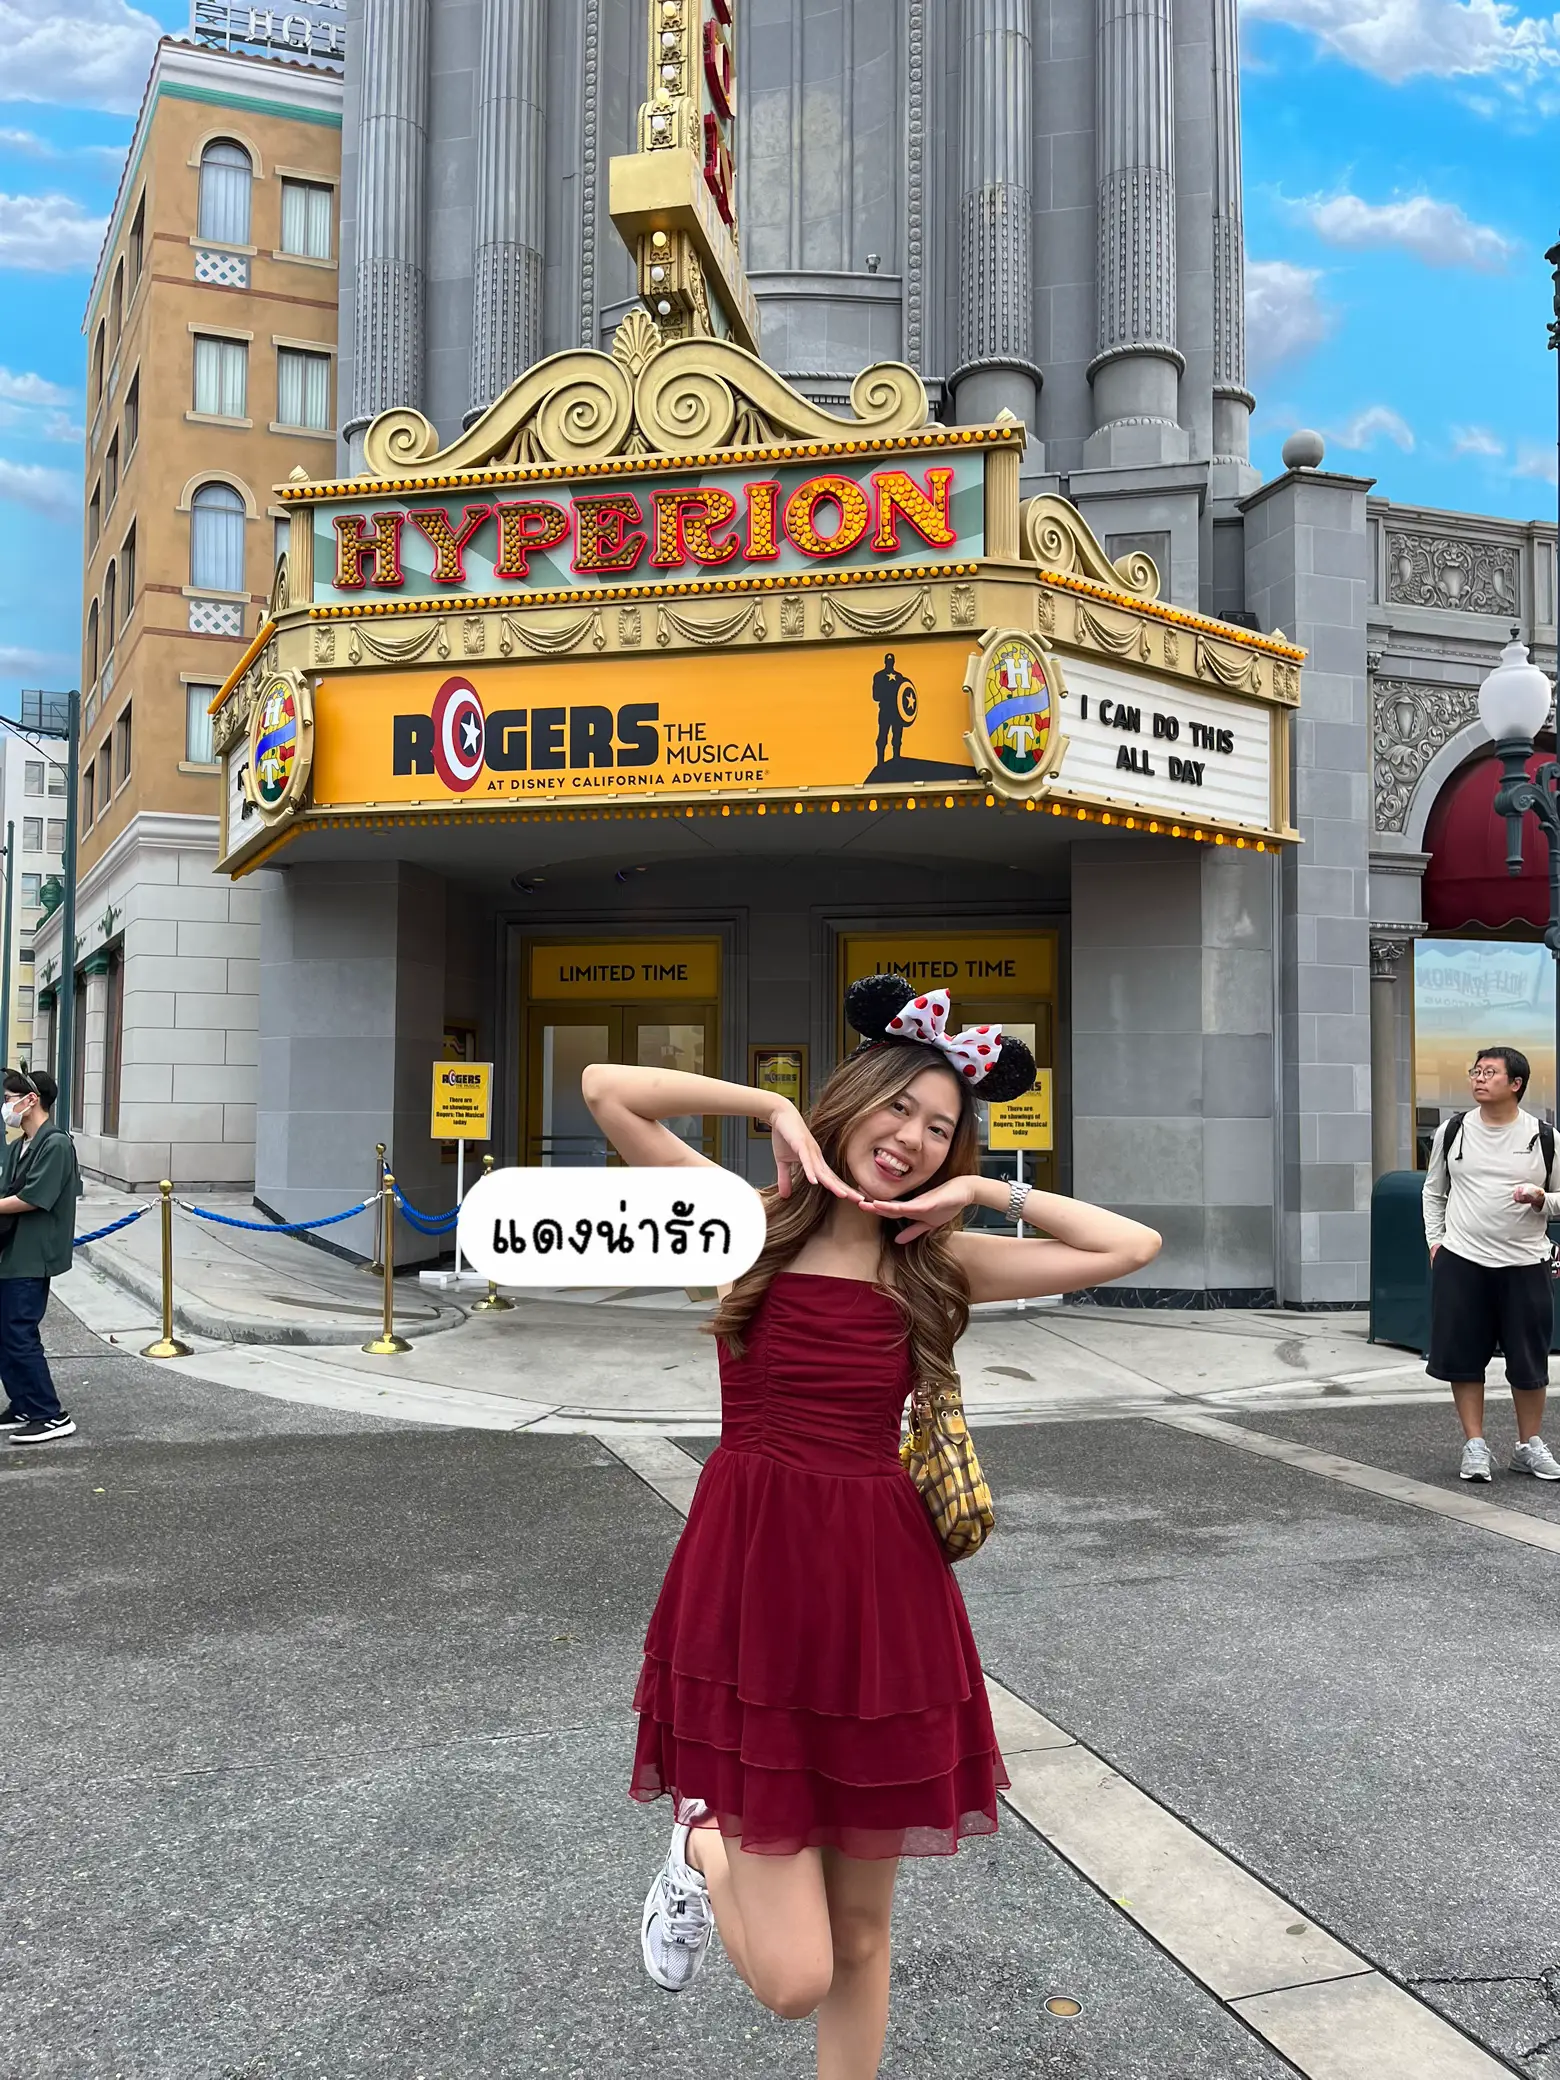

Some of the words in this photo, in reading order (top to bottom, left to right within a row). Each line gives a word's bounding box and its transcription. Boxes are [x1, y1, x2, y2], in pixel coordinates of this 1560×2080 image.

[332, 467, 955, 589] HYPERION
[393, 676, 659, 791] ROGERS
[663, 723, 706, 742] THE
[1081, 695, 1088, 719] I
[1099, 698, 1141, 734] CAN
[1153, 712, 1179, 741] DO
[1188, 721, 1235, 754] THIS
[666, 743, 769, 765] MUSICAL
[1116, 744, 1155, 776] ALL
[1168, 755, 1206, 786] DAY
[487, 780, 505, 790] AT
[511, 777, 566, 790] DISNEY
[572, 774, 665, 788] CALIFORNIA
[559, 965, 635, 982] LIMITED
[641, 964, 688, 981] TIME
[965, 960, 1016, 977] TIME
[442, 1069, 480, 1087] ROGERS
